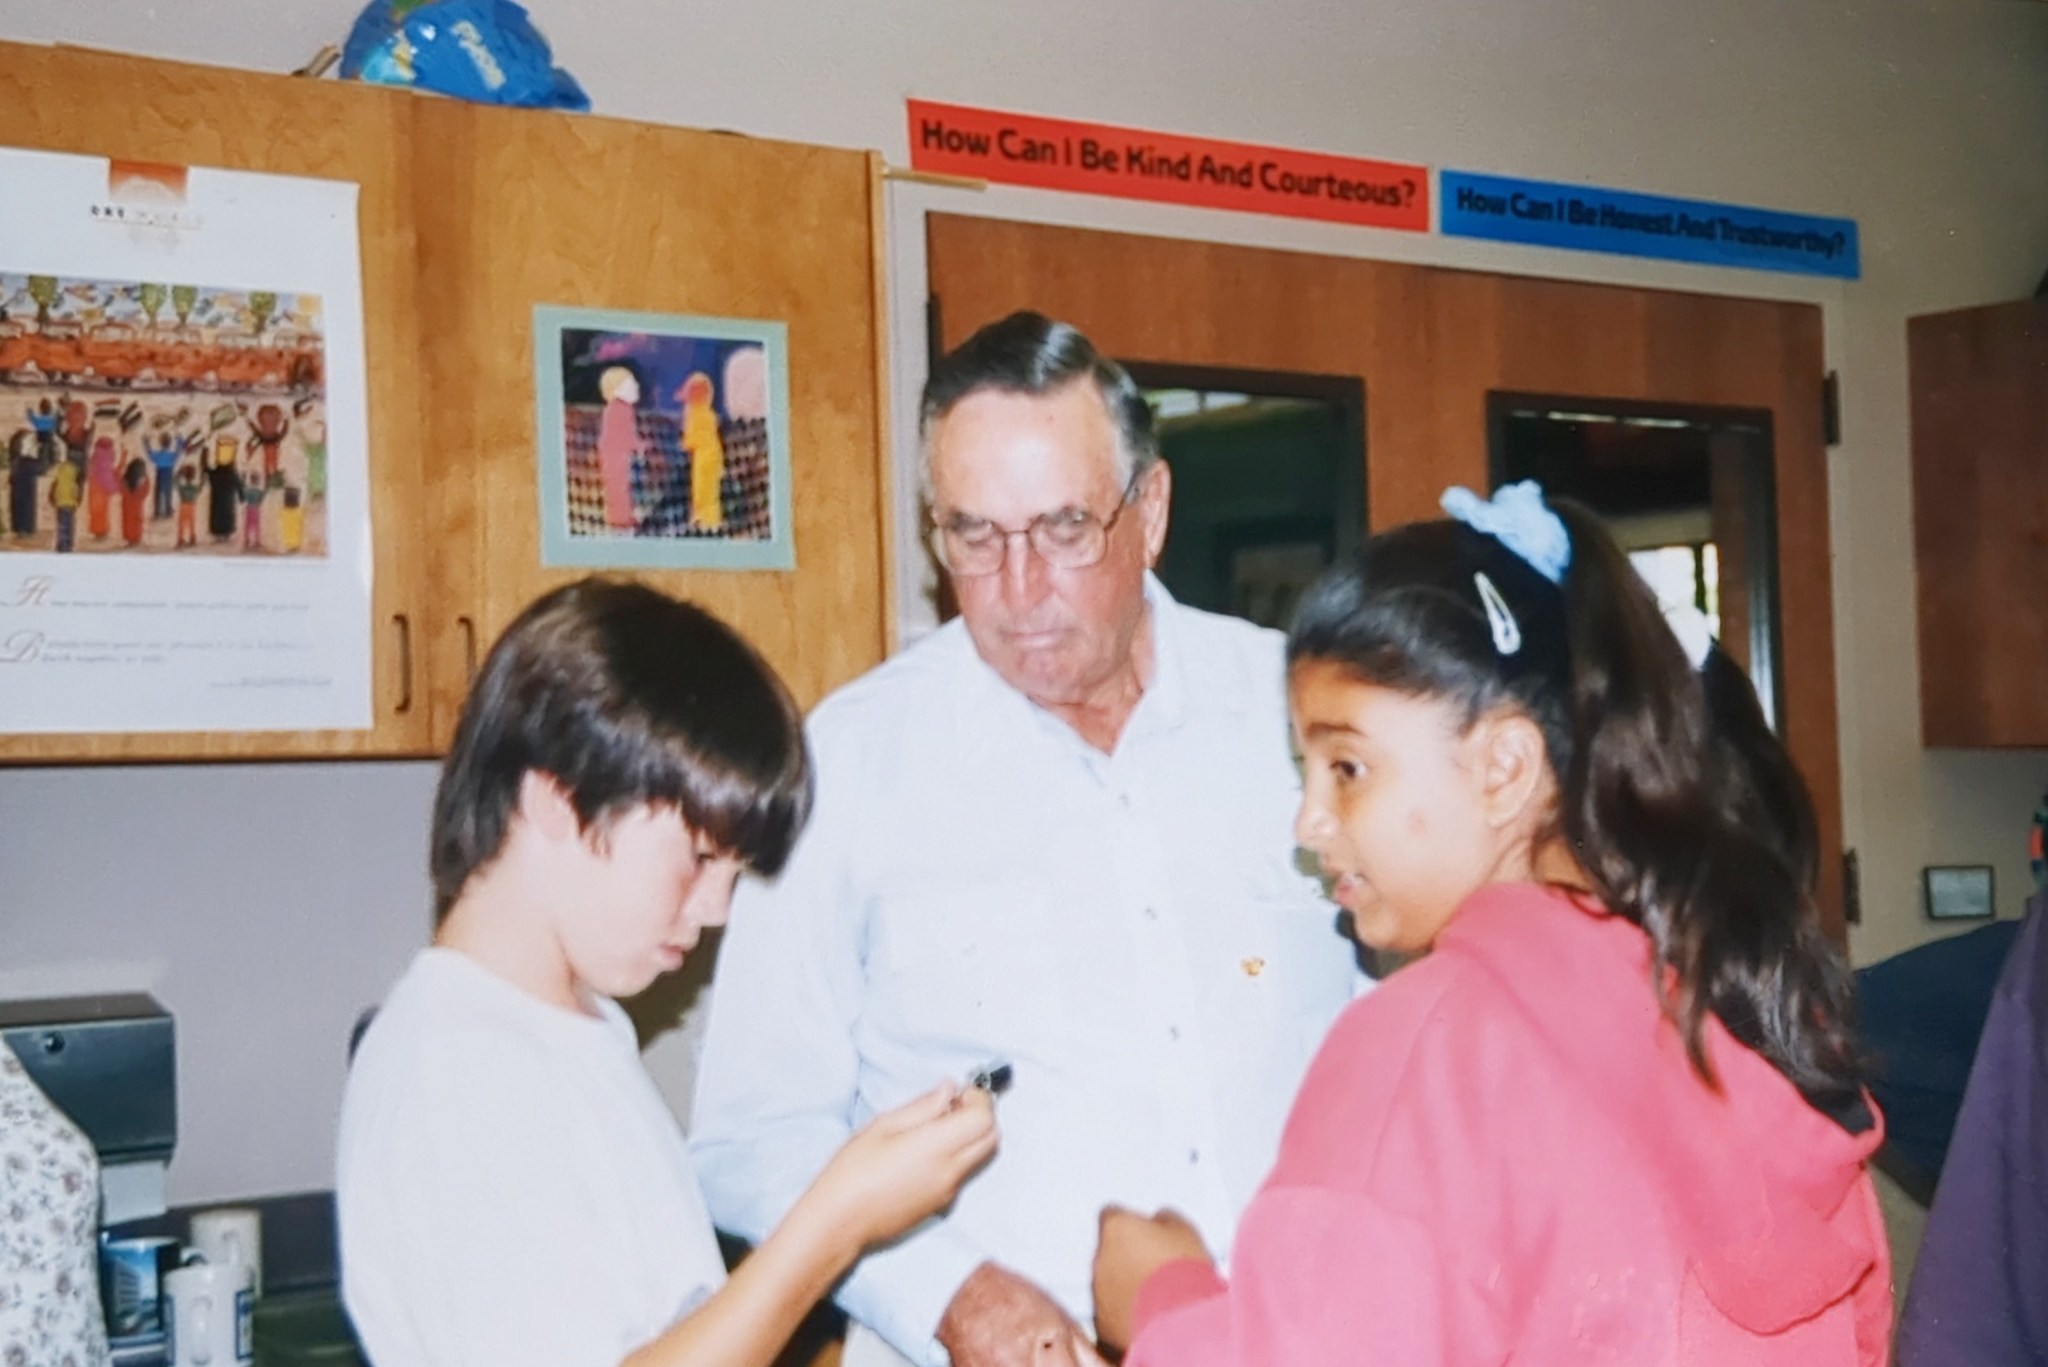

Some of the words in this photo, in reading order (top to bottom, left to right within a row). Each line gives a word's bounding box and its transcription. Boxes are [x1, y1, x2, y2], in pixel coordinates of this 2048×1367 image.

[921, 118, 991, 156] How
[997, 128, 1058, 165] Can
[1064, 137, 1072, 166] I
[1080, 138, 1119, 173] Be
[1126, 145, 1191, 181] Kind
[1198, 155, 1253, 188] And
[1260, 161, 1416, 208] Courteous?
[1457, 187, 1506, 215] How
[1511, 192, 1553, 220] Can
[1557, 197, 1564, 221] I
[1568, 197, 1597, 226] Be
[1600, 203, 1671, 236] Honest
[1678, 212, 1715, 241] And
